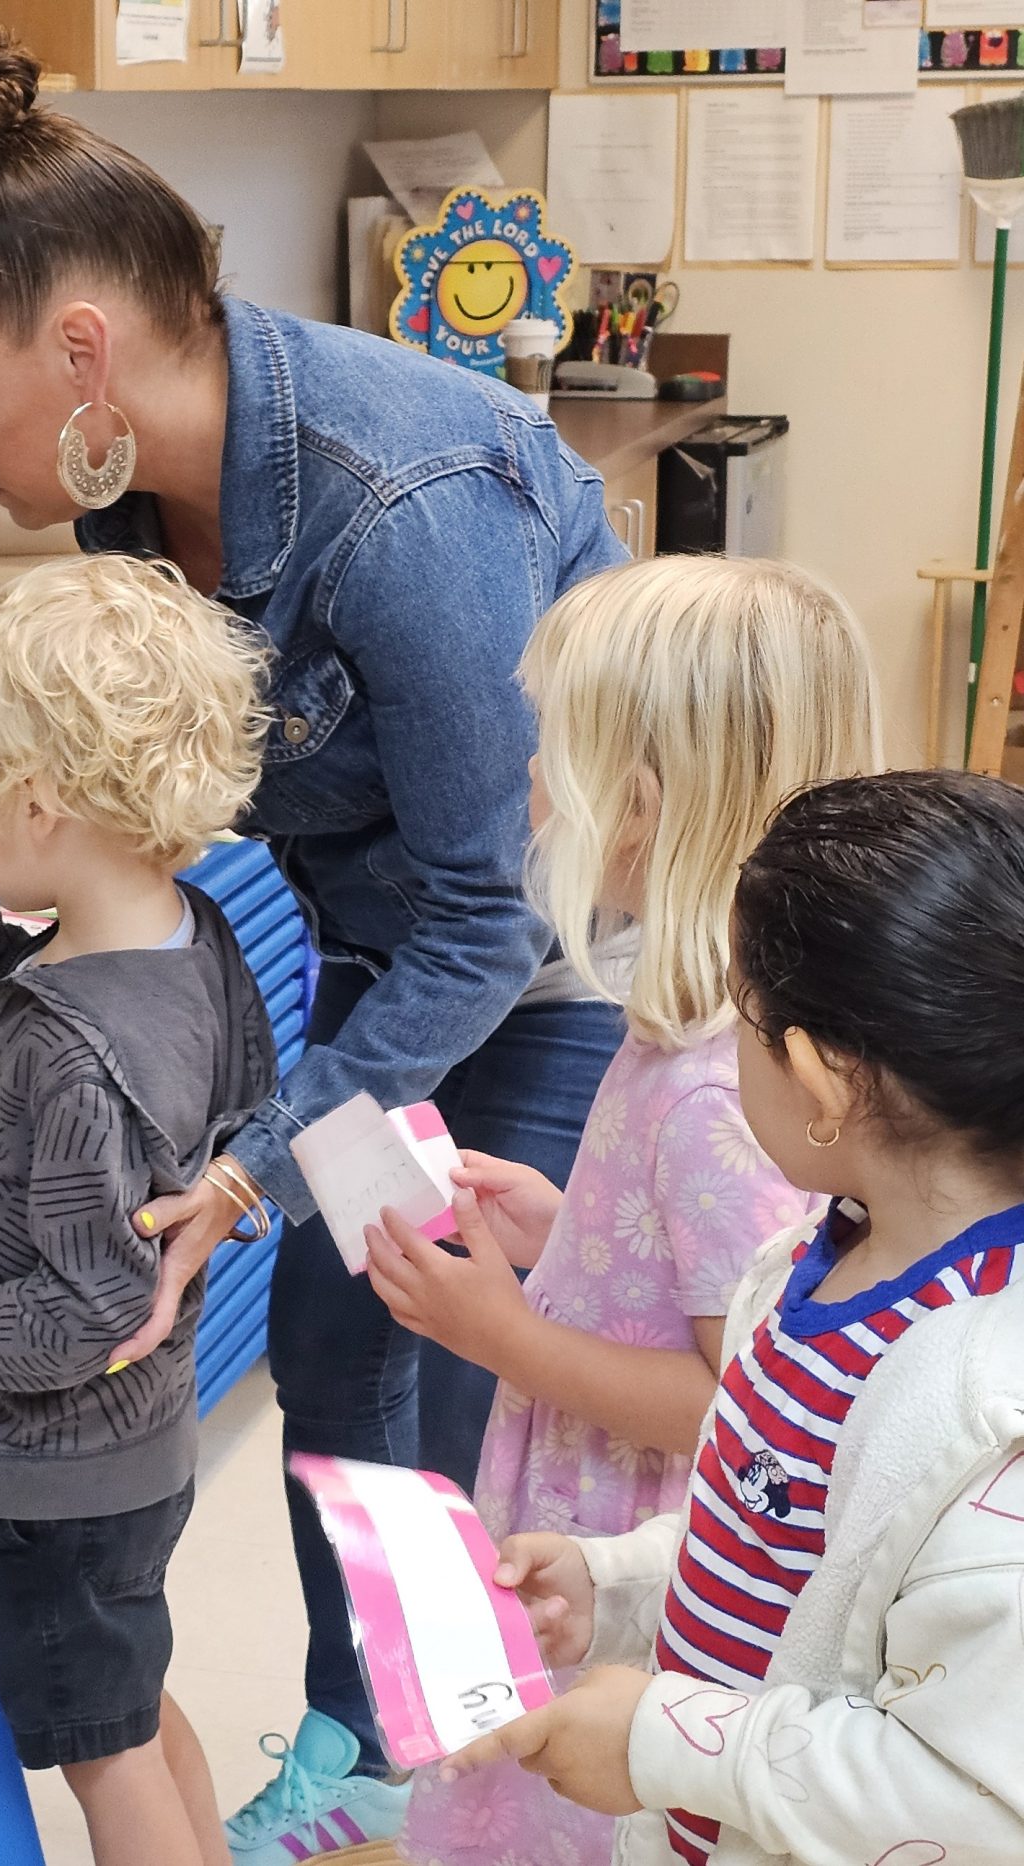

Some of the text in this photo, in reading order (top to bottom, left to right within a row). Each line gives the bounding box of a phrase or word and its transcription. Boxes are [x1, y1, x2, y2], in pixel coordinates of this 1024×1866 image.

[449, 219, 485, 246] THE
[492, 219, 539, 258] LORD
[435, 324, 490, 356] YOUR
